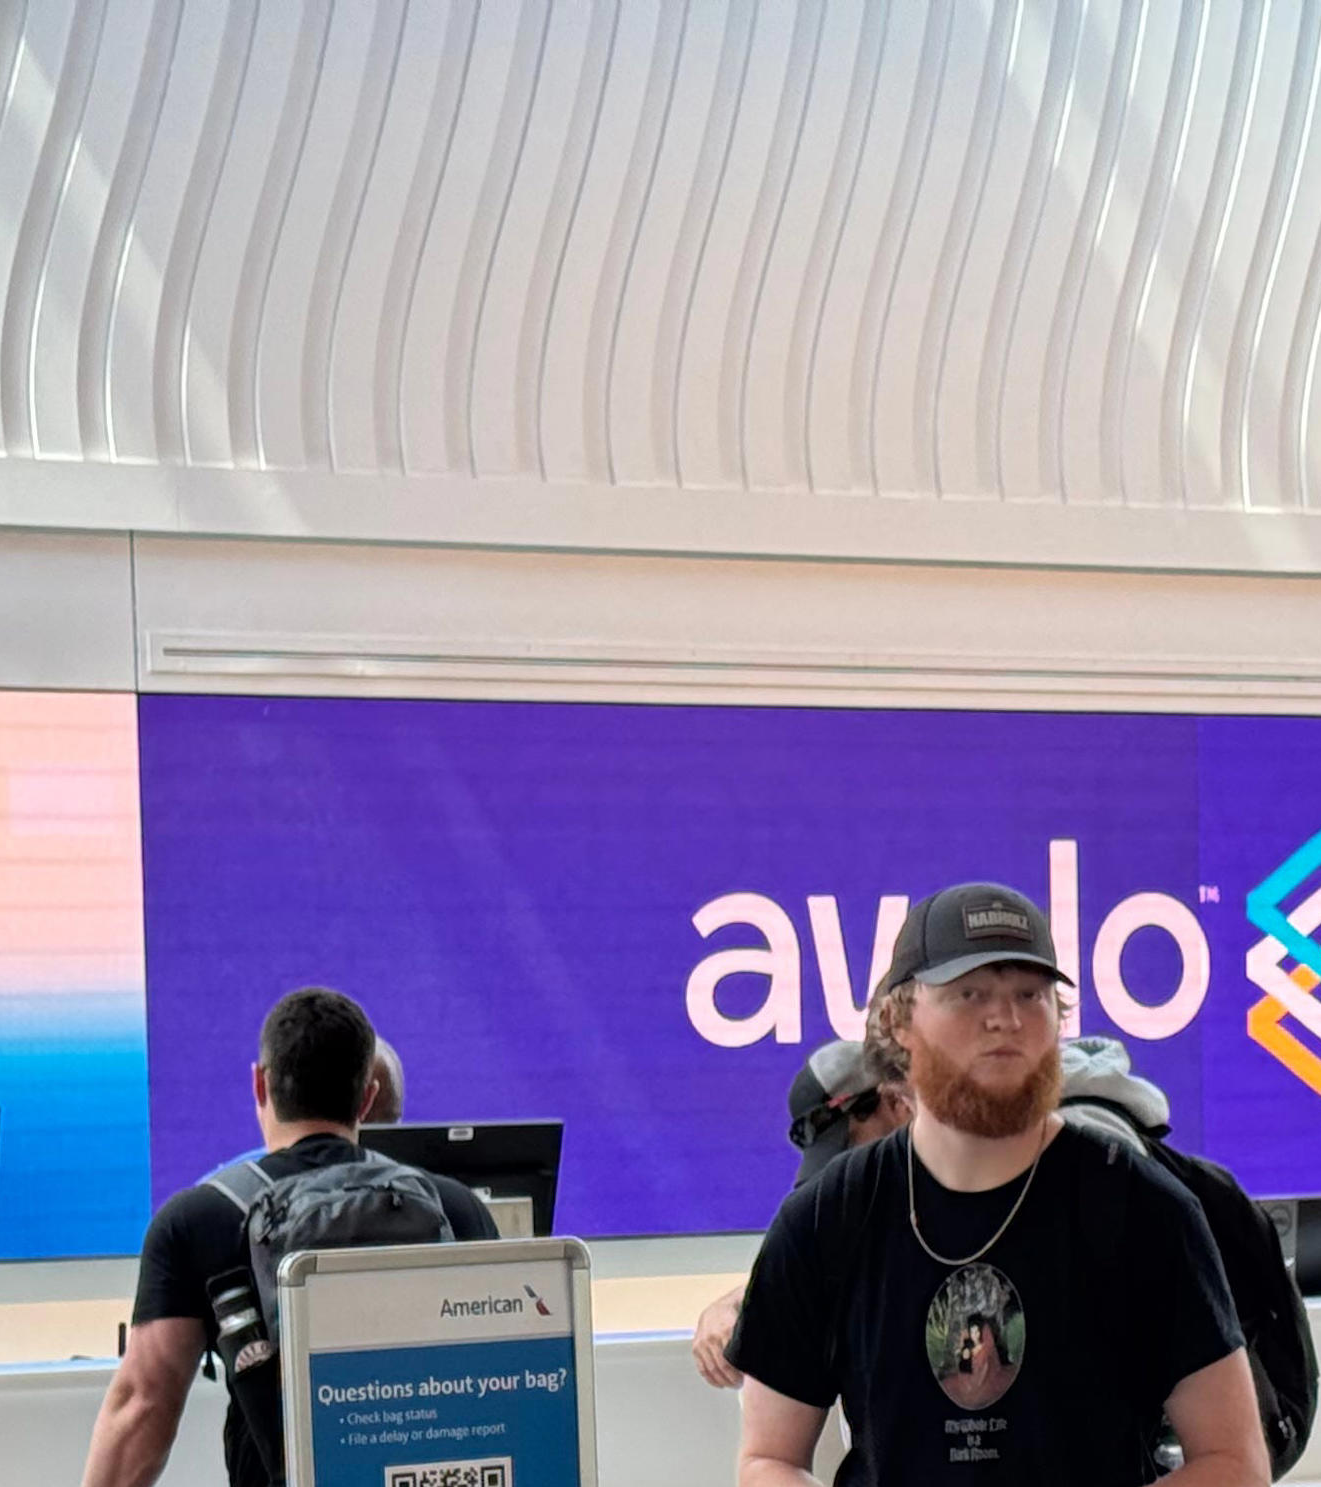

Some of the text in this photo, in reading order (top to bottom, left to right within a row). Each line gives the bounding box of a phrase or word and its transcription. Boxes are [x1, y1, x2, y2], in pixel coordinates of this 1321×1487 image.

[685, 839, 1211, 1049] avlo
[440, 1295, 523, 1318] American
[318, 1368, 567, 1405] Questions about your bag?
[347, 1408, 438, 1426] Check bag status
[348, 1423, 506, 1446] File a delay or damage report
